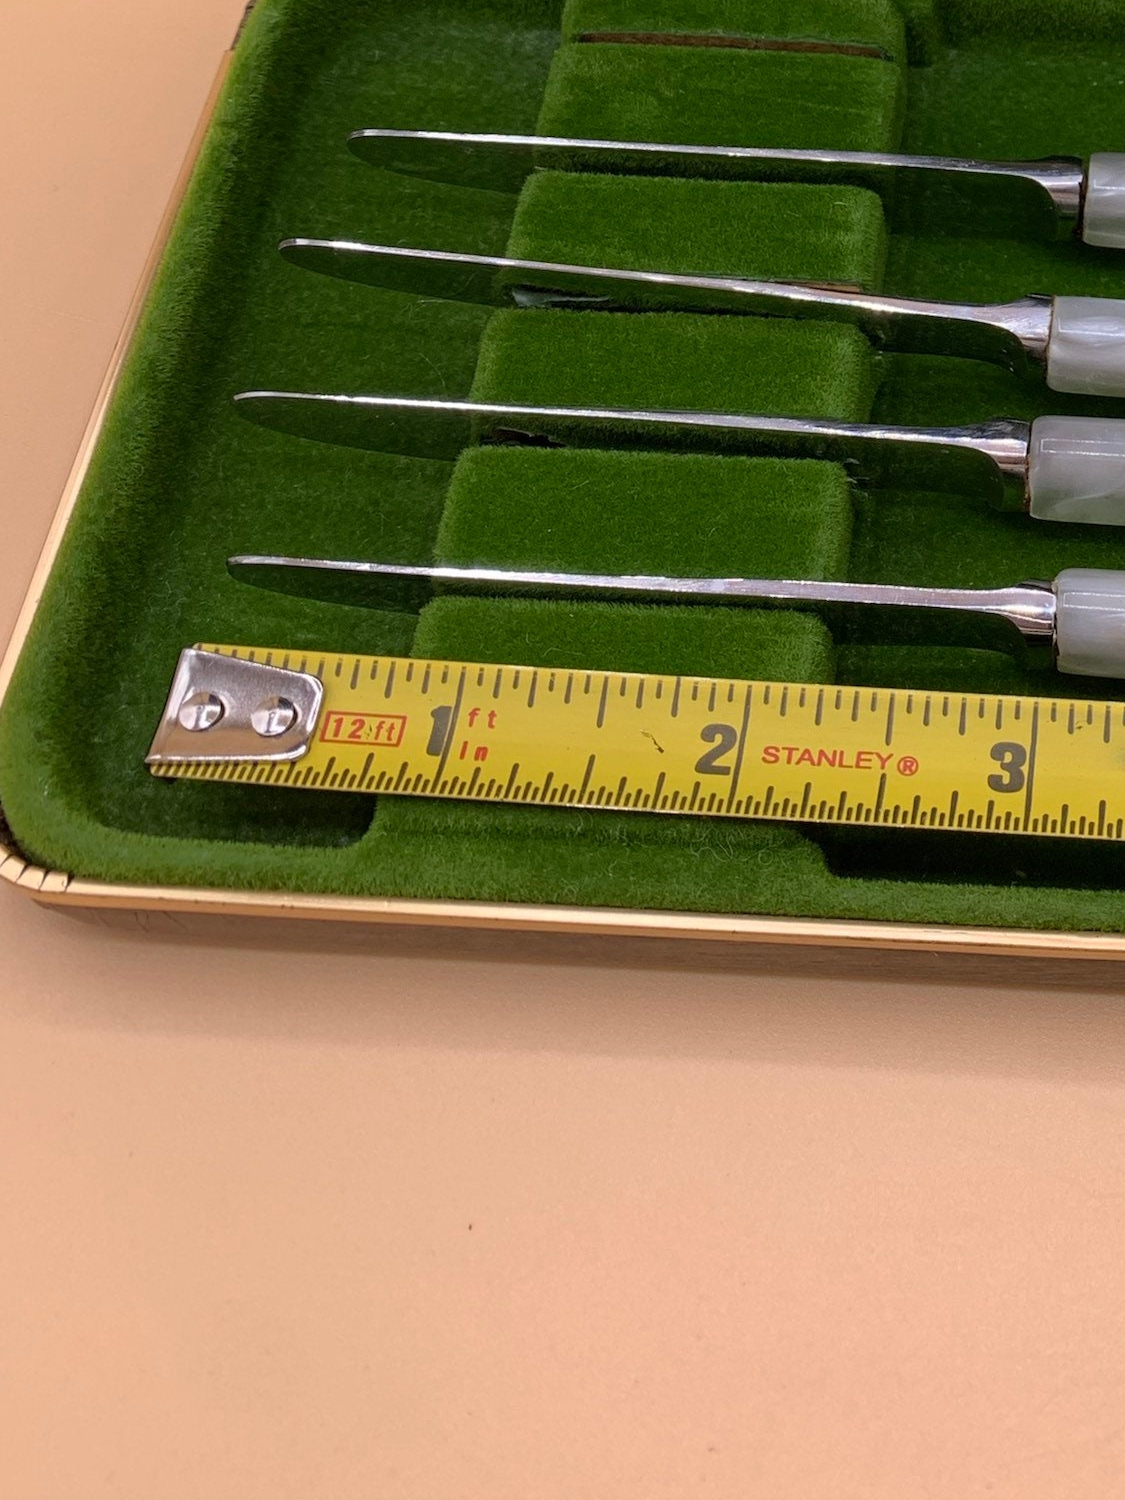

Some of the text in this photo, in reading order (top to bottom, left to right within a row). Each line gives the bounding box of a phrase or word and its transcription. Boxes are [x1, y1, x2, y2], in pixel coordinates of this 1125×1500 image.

[427, 705, 453, 757] 1
[695, 724, 738, 776] 2
[987, 741, 1027, 793] 3
